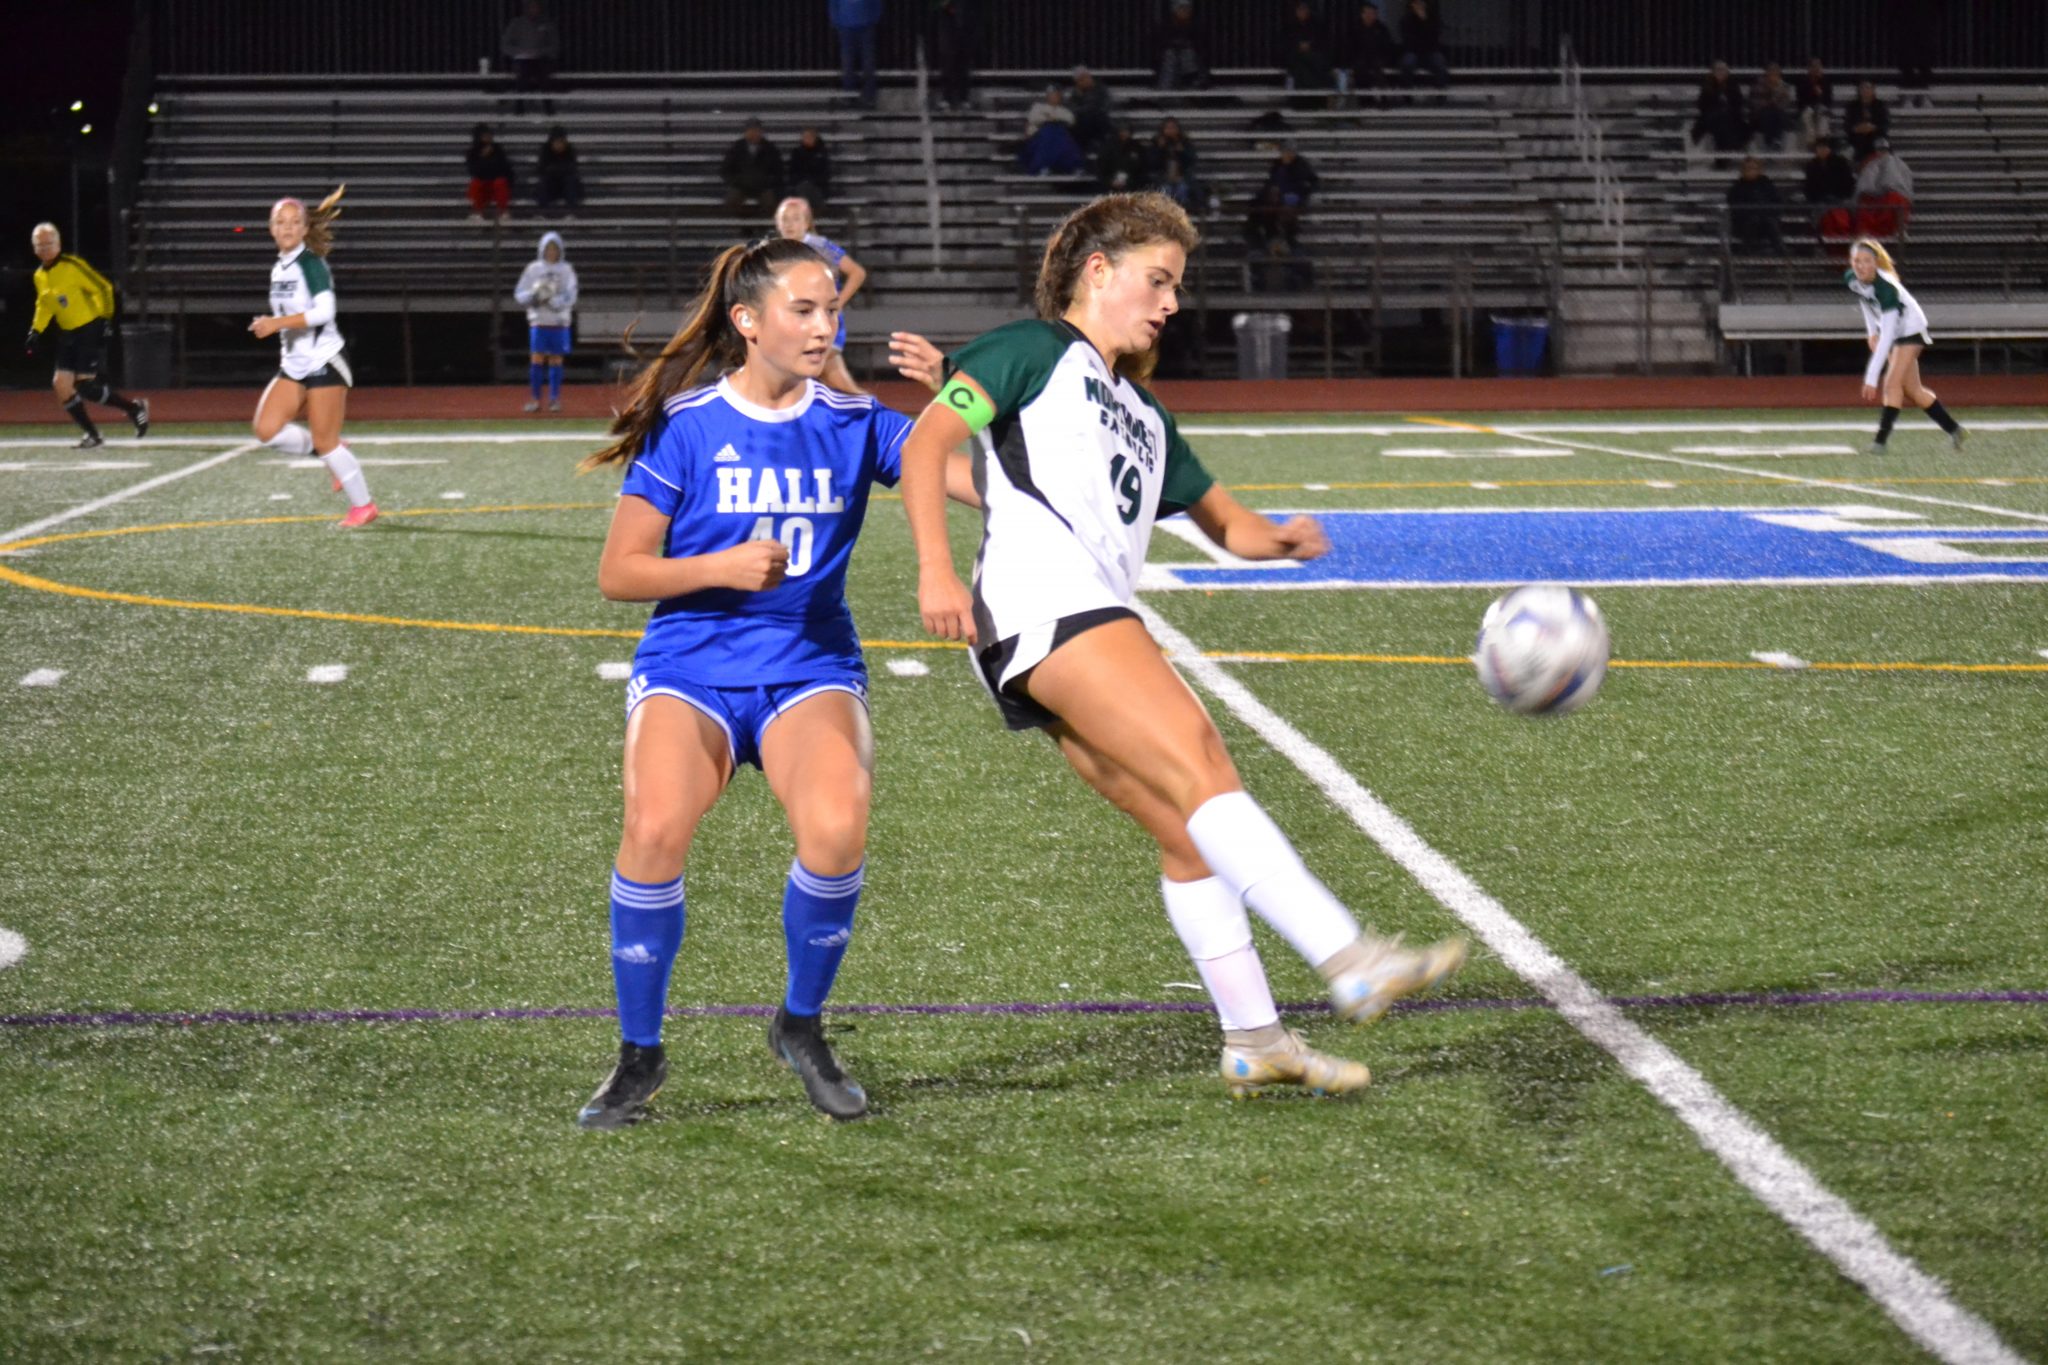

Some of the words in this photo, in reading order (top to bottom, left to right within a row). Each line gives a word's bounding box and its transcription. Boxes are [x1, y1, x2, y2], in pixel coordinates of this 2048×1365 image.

[949, 387, 974, 409] C
[716, 467, 844, 513] HALL
[1110, 453, 1142, 525] 19
